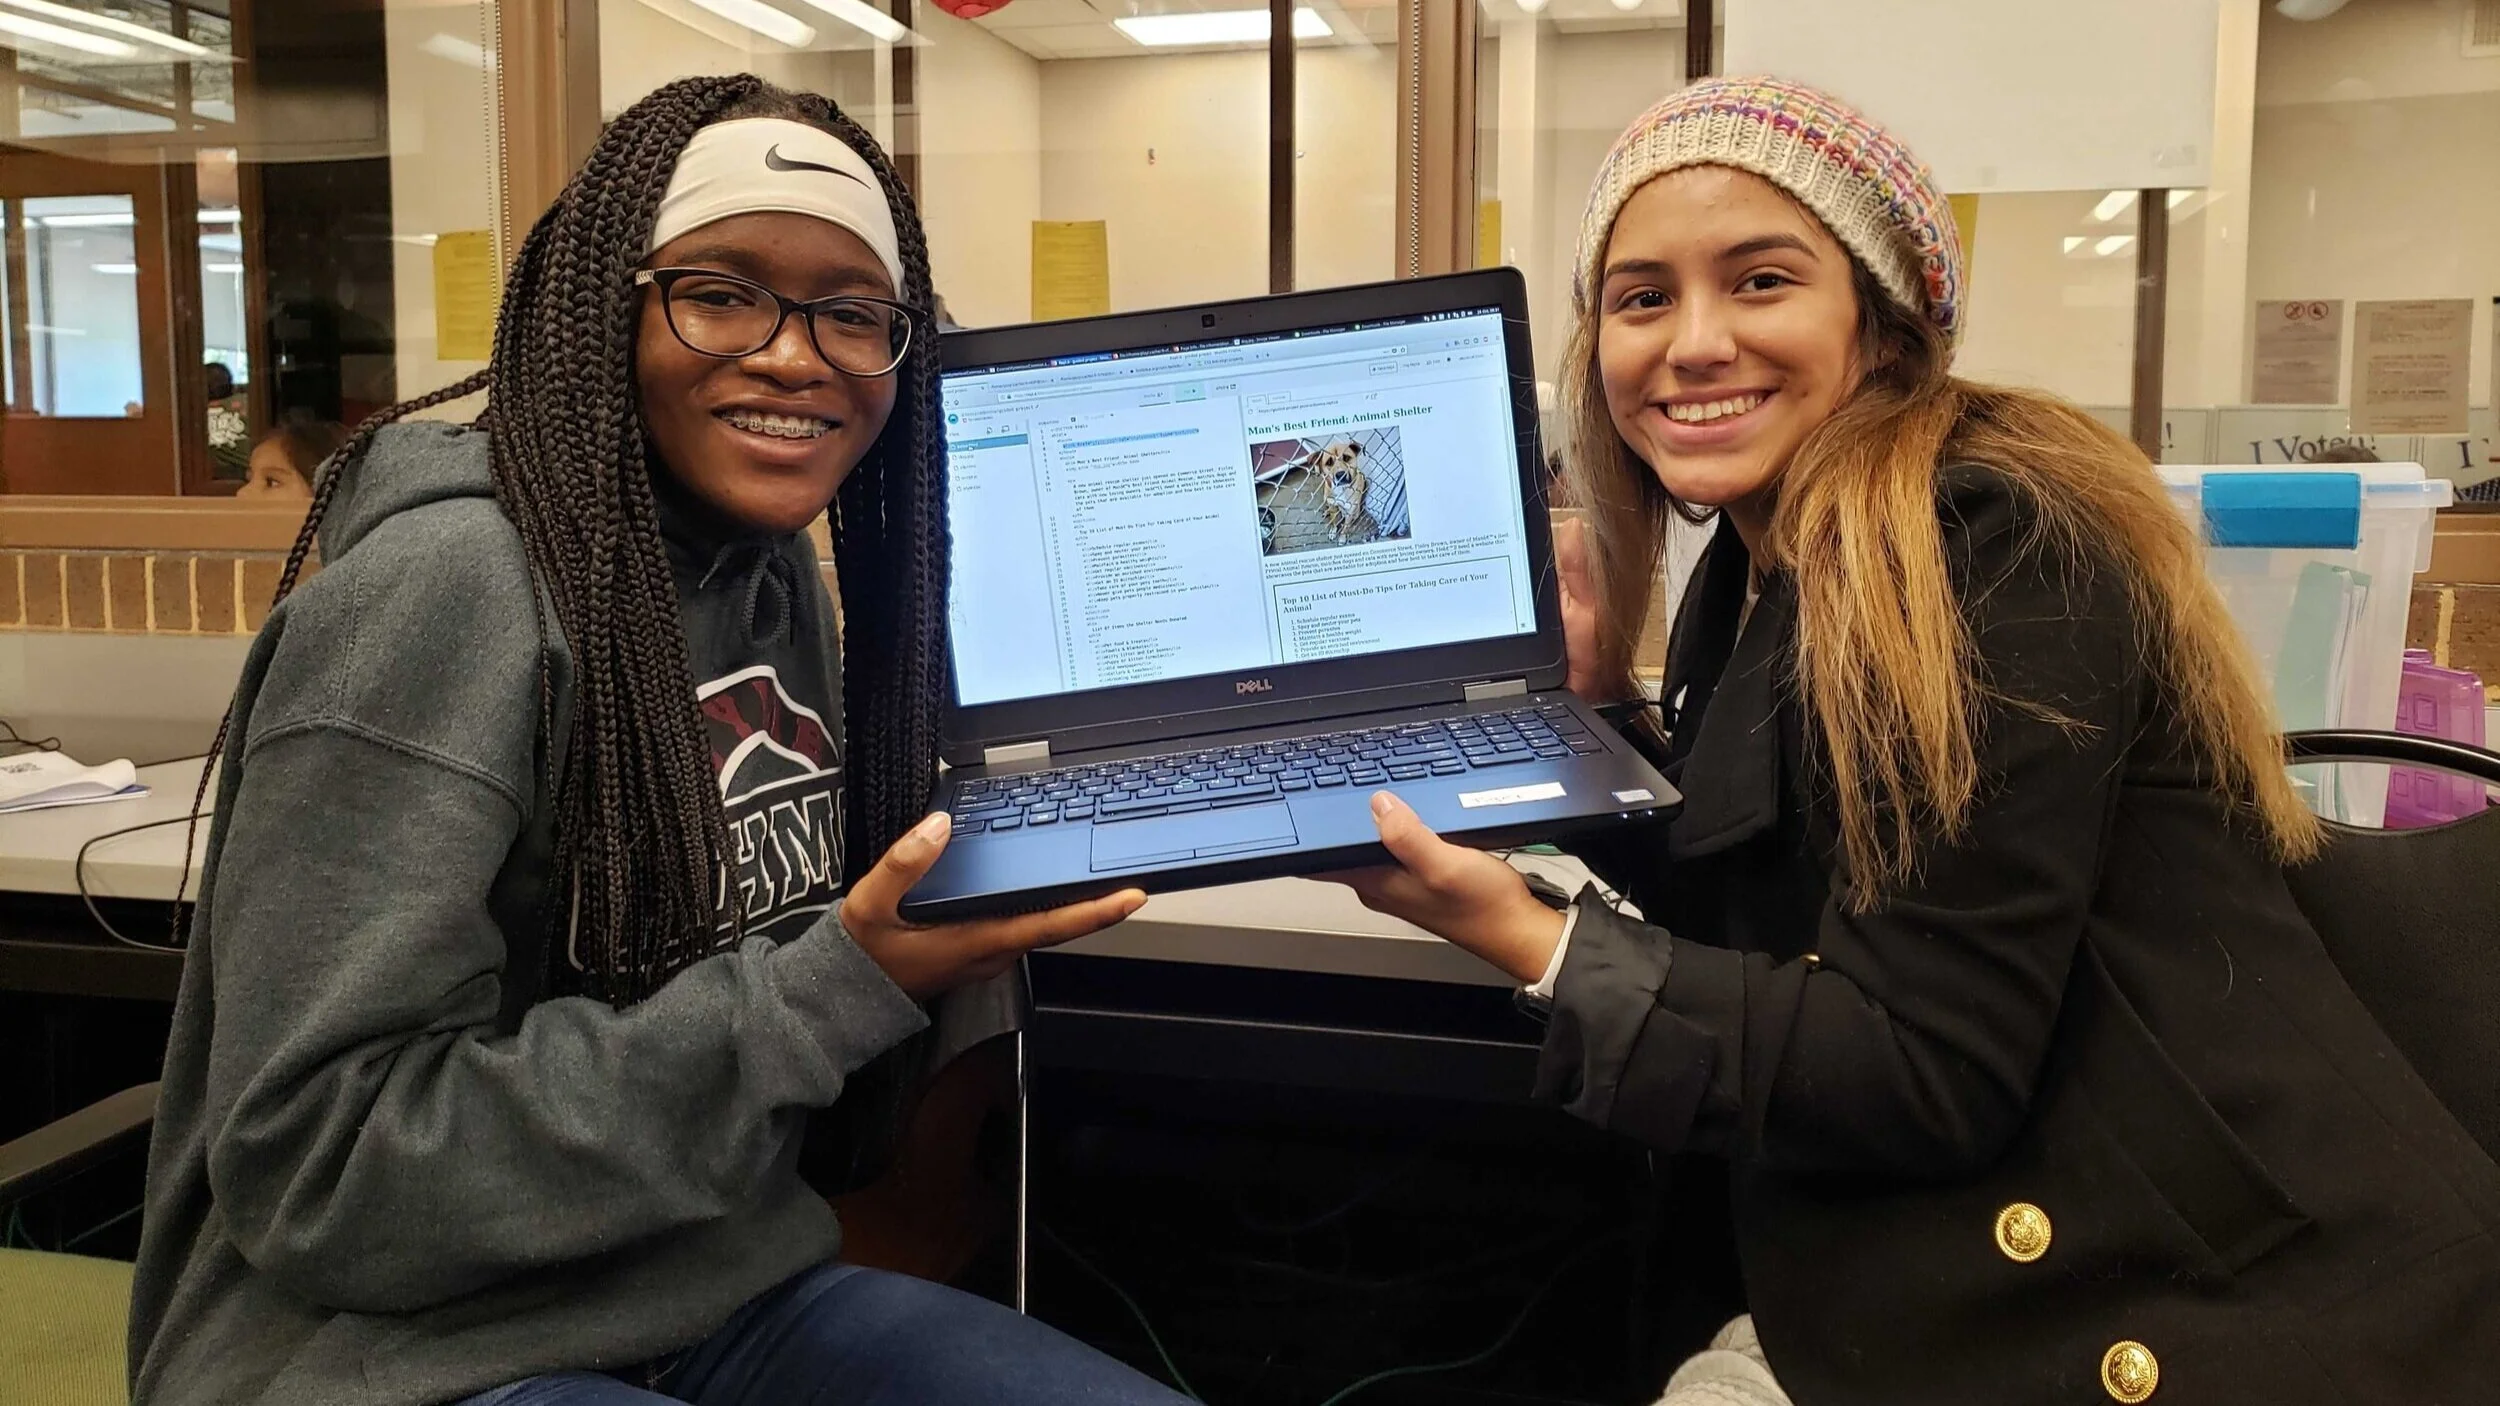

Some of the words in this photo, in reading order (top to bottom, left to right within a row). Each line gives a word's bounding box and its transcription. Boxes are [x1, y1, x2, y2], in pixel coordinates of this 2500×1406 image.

[1247, 422, 1280, 435] Man's
[1283, 419, 1306, 431] Best
[1310, 414, 1348, 428] Friend:
[1351, 409, 1390, 422] Animal
[1393, 404, 1433, 417] Shelter
[1281, 596, 1297, 606] Top
[1298, 594, 1310, 602] 10
[1311, 592, 1327, 601] List
[1328, 591, 1338, 599] of
[1338, 586, 1373, 597] Must-Do
[1375, 584, 1393, 594] Tips
[1395, 582, 1407, 590] for
[1408, 578, 1437, 590] Taking
[1438, 575, 1457, 584] Care
[1468, 571, 1488, 581] Your
[1282, 603, 1312, 614] Animal
[1236, 678, 1273, 695] DELL
